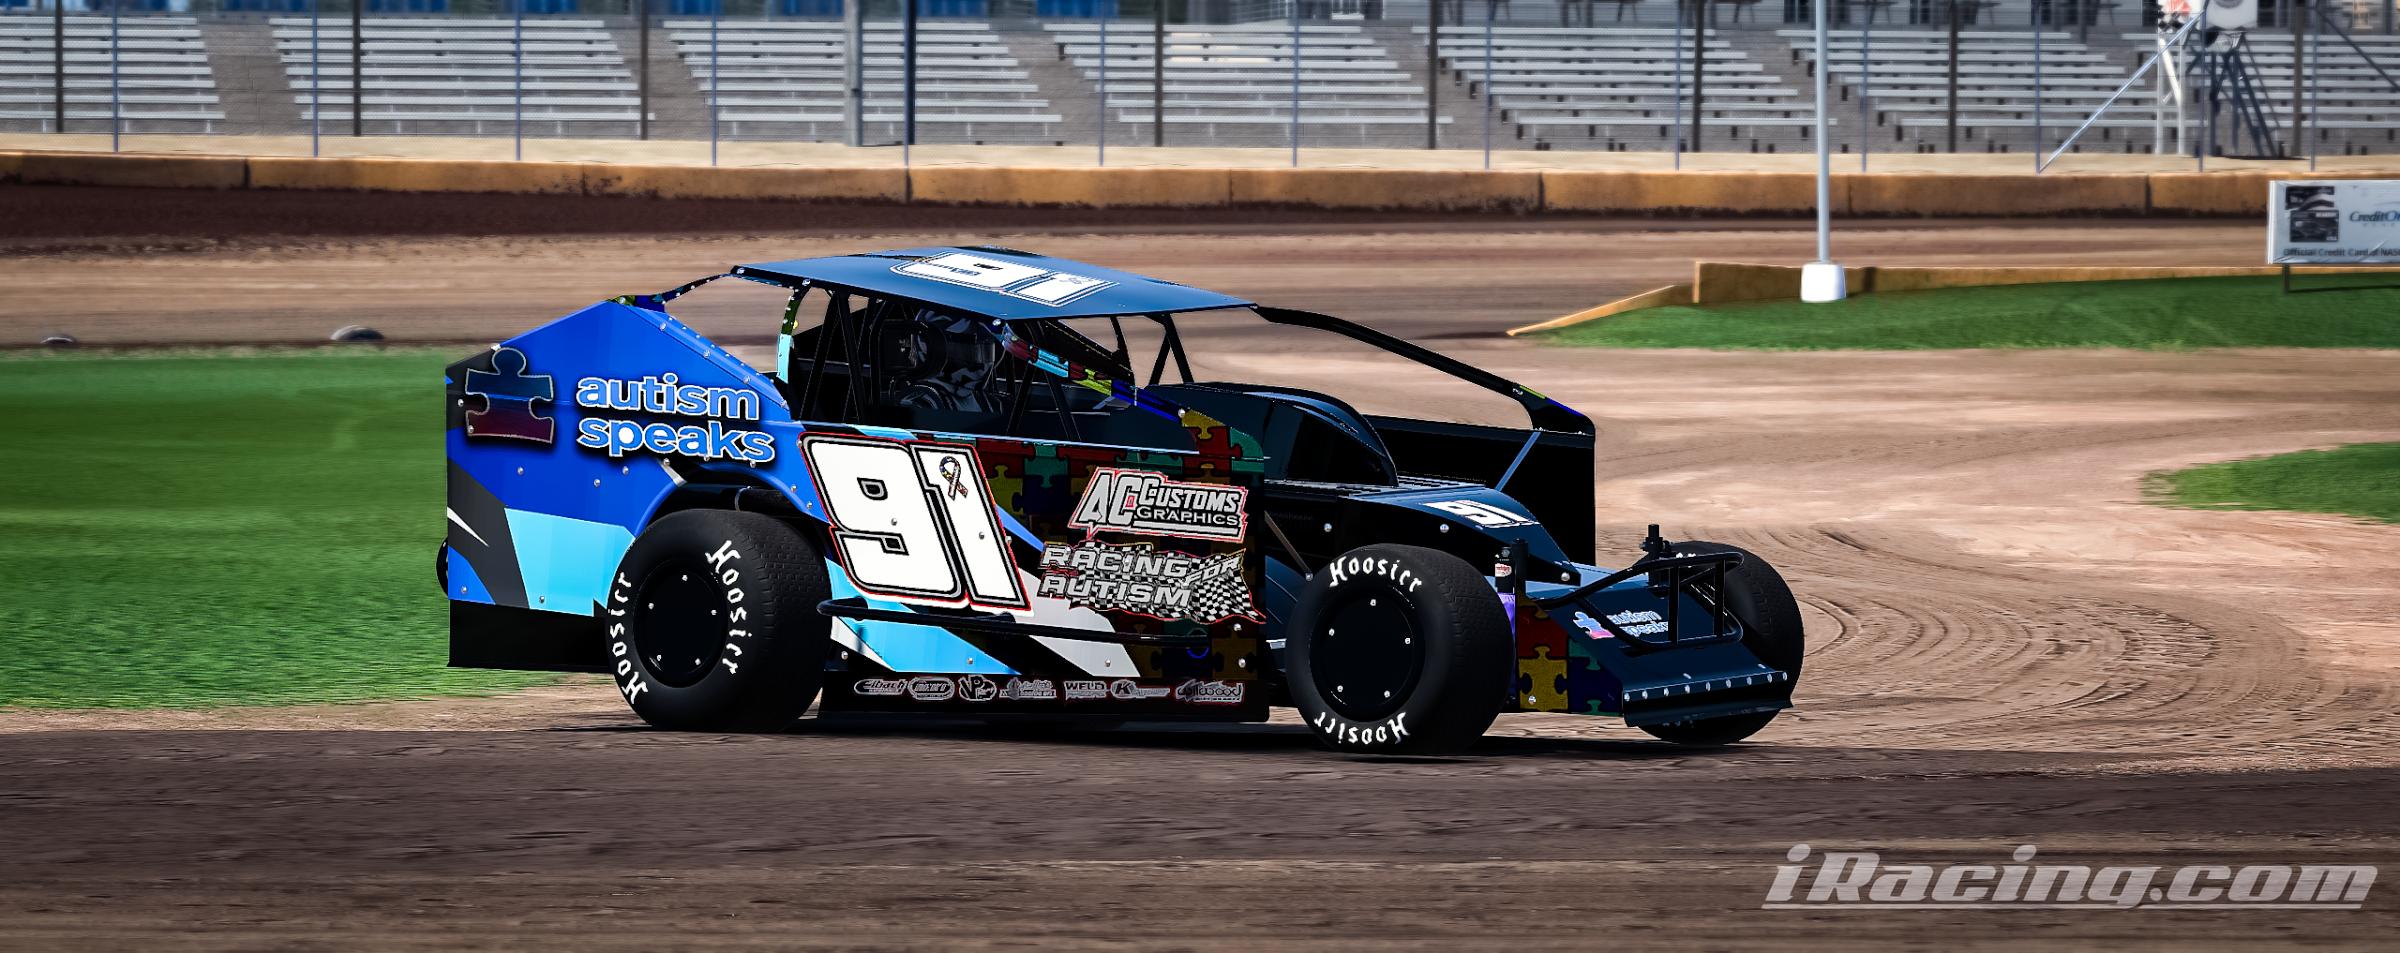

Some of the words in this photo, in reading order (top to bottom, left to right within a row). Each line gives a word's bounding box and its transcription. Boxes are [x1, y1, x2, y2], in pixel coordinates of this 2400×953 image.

[890, 251, 1120, 308] 91
[576, 373, 760, 420] autism
[577, 417, 775, 463] speaks
[1078, 473, 1142, 526] AC
[1135, 505, 1239, 526] GRAPHICS
[1138, 475, 1241, 513] CUSTOMS
[1421, 500, 1540, 528] 91
[799, 433, 1030, 612] 91
[1040, 546, 1191, 578] RACING
[1183, 556, 1242, 587] FOR
[1329, 556, 1422, 592] Hoosier
[704, 540, 752, 675] Hoosier
[1040, 574, 1193, 608] AUTISM
[608, 572, 649, 704] Hoosier
[1314, 712, 1410, 744] Hoosier
